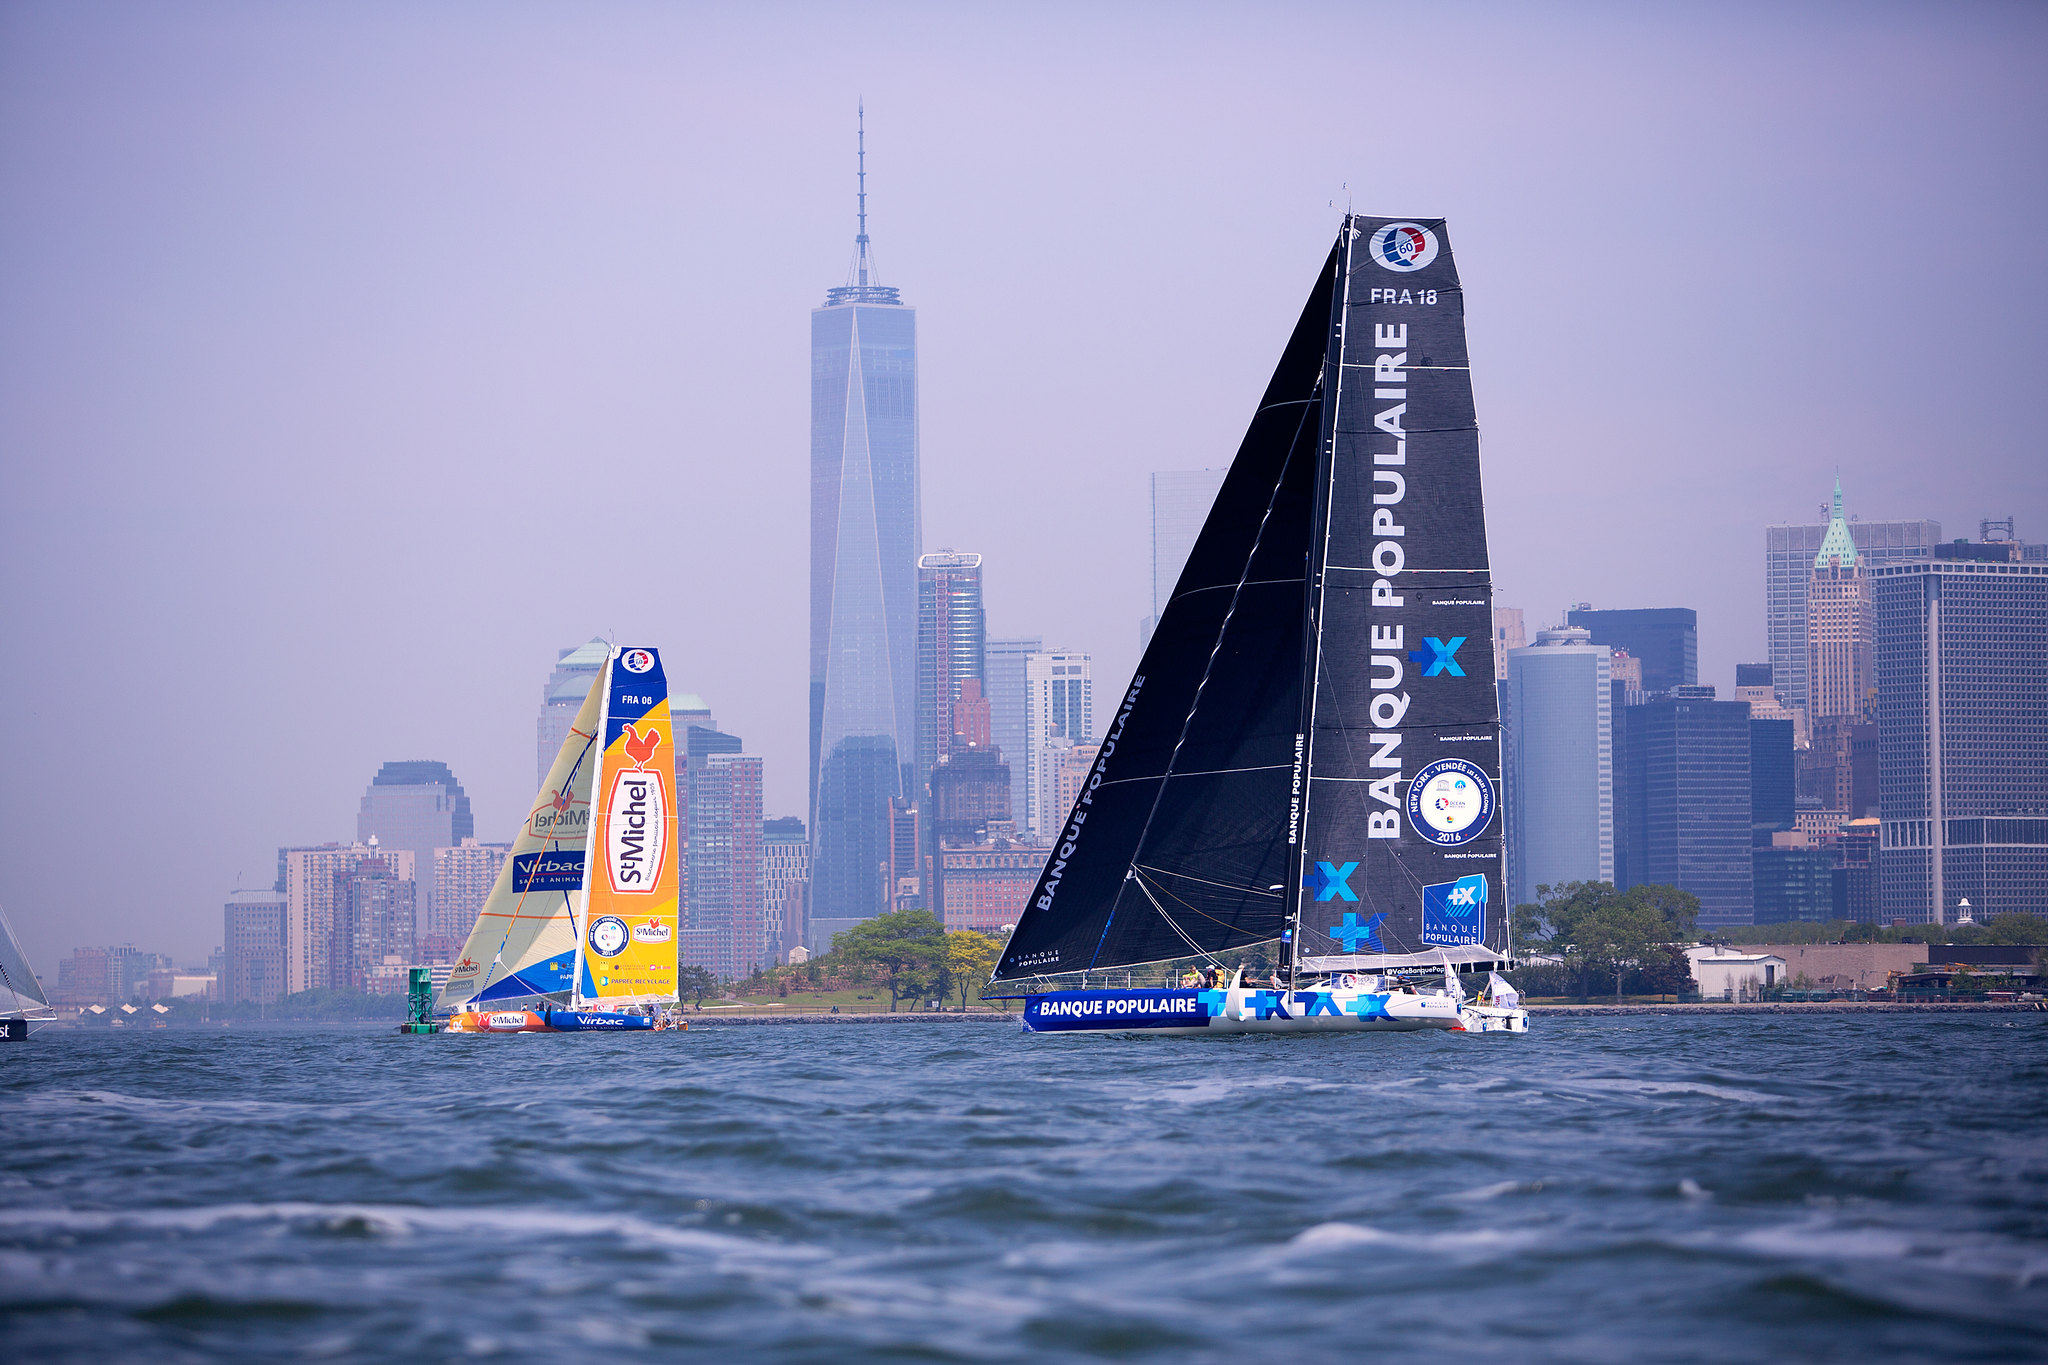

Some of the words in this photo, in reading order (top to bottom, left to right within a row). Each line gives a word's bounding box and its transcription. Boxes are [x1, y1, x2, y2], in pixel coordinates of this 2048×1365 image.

[1399, 242, 1413, 254] 60
[1370, 288, 1413, 304] FRA
[1417, 289, 1438, 305] 18
[1372, 322, 1408, 607] POPULAIRE
[622, 695, 640, 704] FRA
[1368, 624, 1411, 839] BANQUE
[1292, 733, 1304, 795] POPULAIRE
[1434, 762, 1467, 772] VENDÉE
[1413, 772, 1430, 792] YORK
[1036, 810, 1088, 911] BANQUE
[1082, 674, 1146, 805] POPULAIRE
[1410, 794, 1418, 812] NEW
[1288, 797, 1300, 844] BANQUE
[1436, 832, 1461, 842] 2016
[518, 860, 584, 874] Virbac
[1426, 924, 1477, 934] BANQUE
[1426, 933, 1476, 945] POPULAIRE
[1018, 950, 1058, 960] BANQUE
[1019, 956, 1059, 966] POPULAIRE
[1040, 1000, 1102, 1018] BANQUE
[1106, 998, 1196, 1015] POPULAIRE
[453, 1020, 463, 1031] 06
[577, 1016, 624, 1026] Virbac
